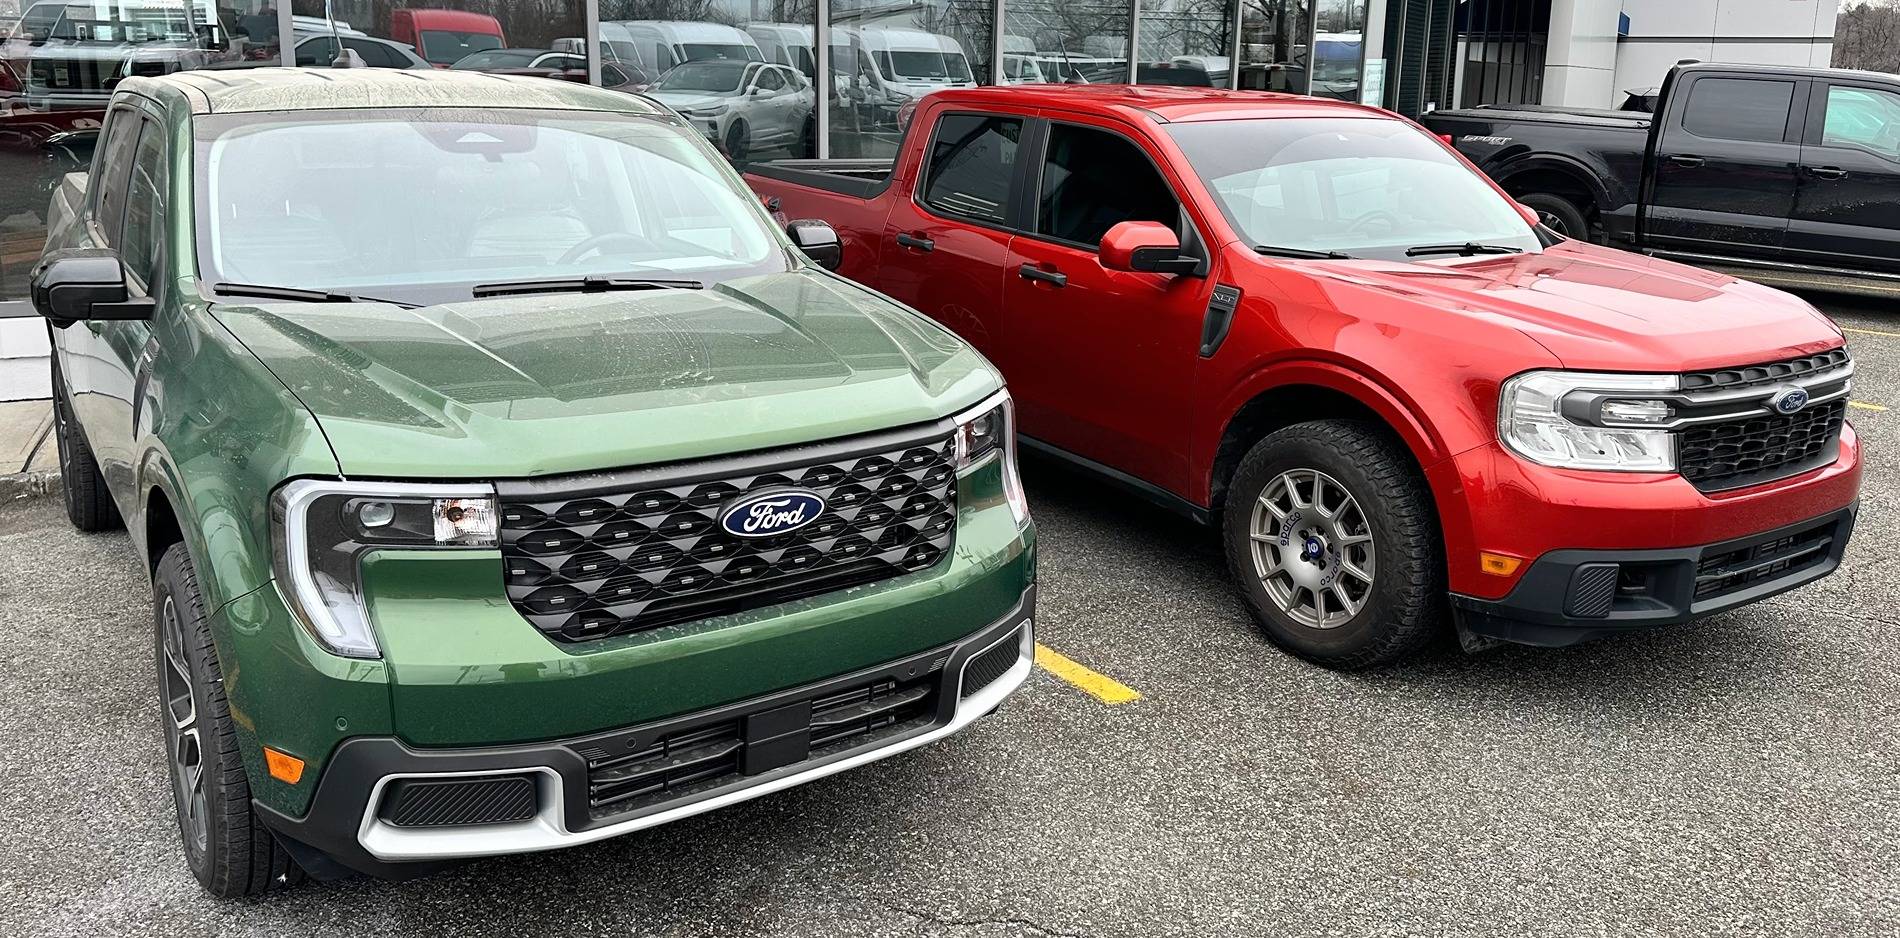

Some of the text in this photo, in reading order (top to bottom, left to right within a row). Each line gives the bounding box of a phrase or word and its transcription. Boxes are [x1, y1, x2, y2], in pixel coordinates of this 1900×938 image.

[1213, 292, 1235, 303] XLT
[1785, 394, 1804, 409] Ford
[743, 499, 807, 532] Ford
[1280, 511, 1302, 547] sparco
[1320, 551, 1341, 586] sparco
